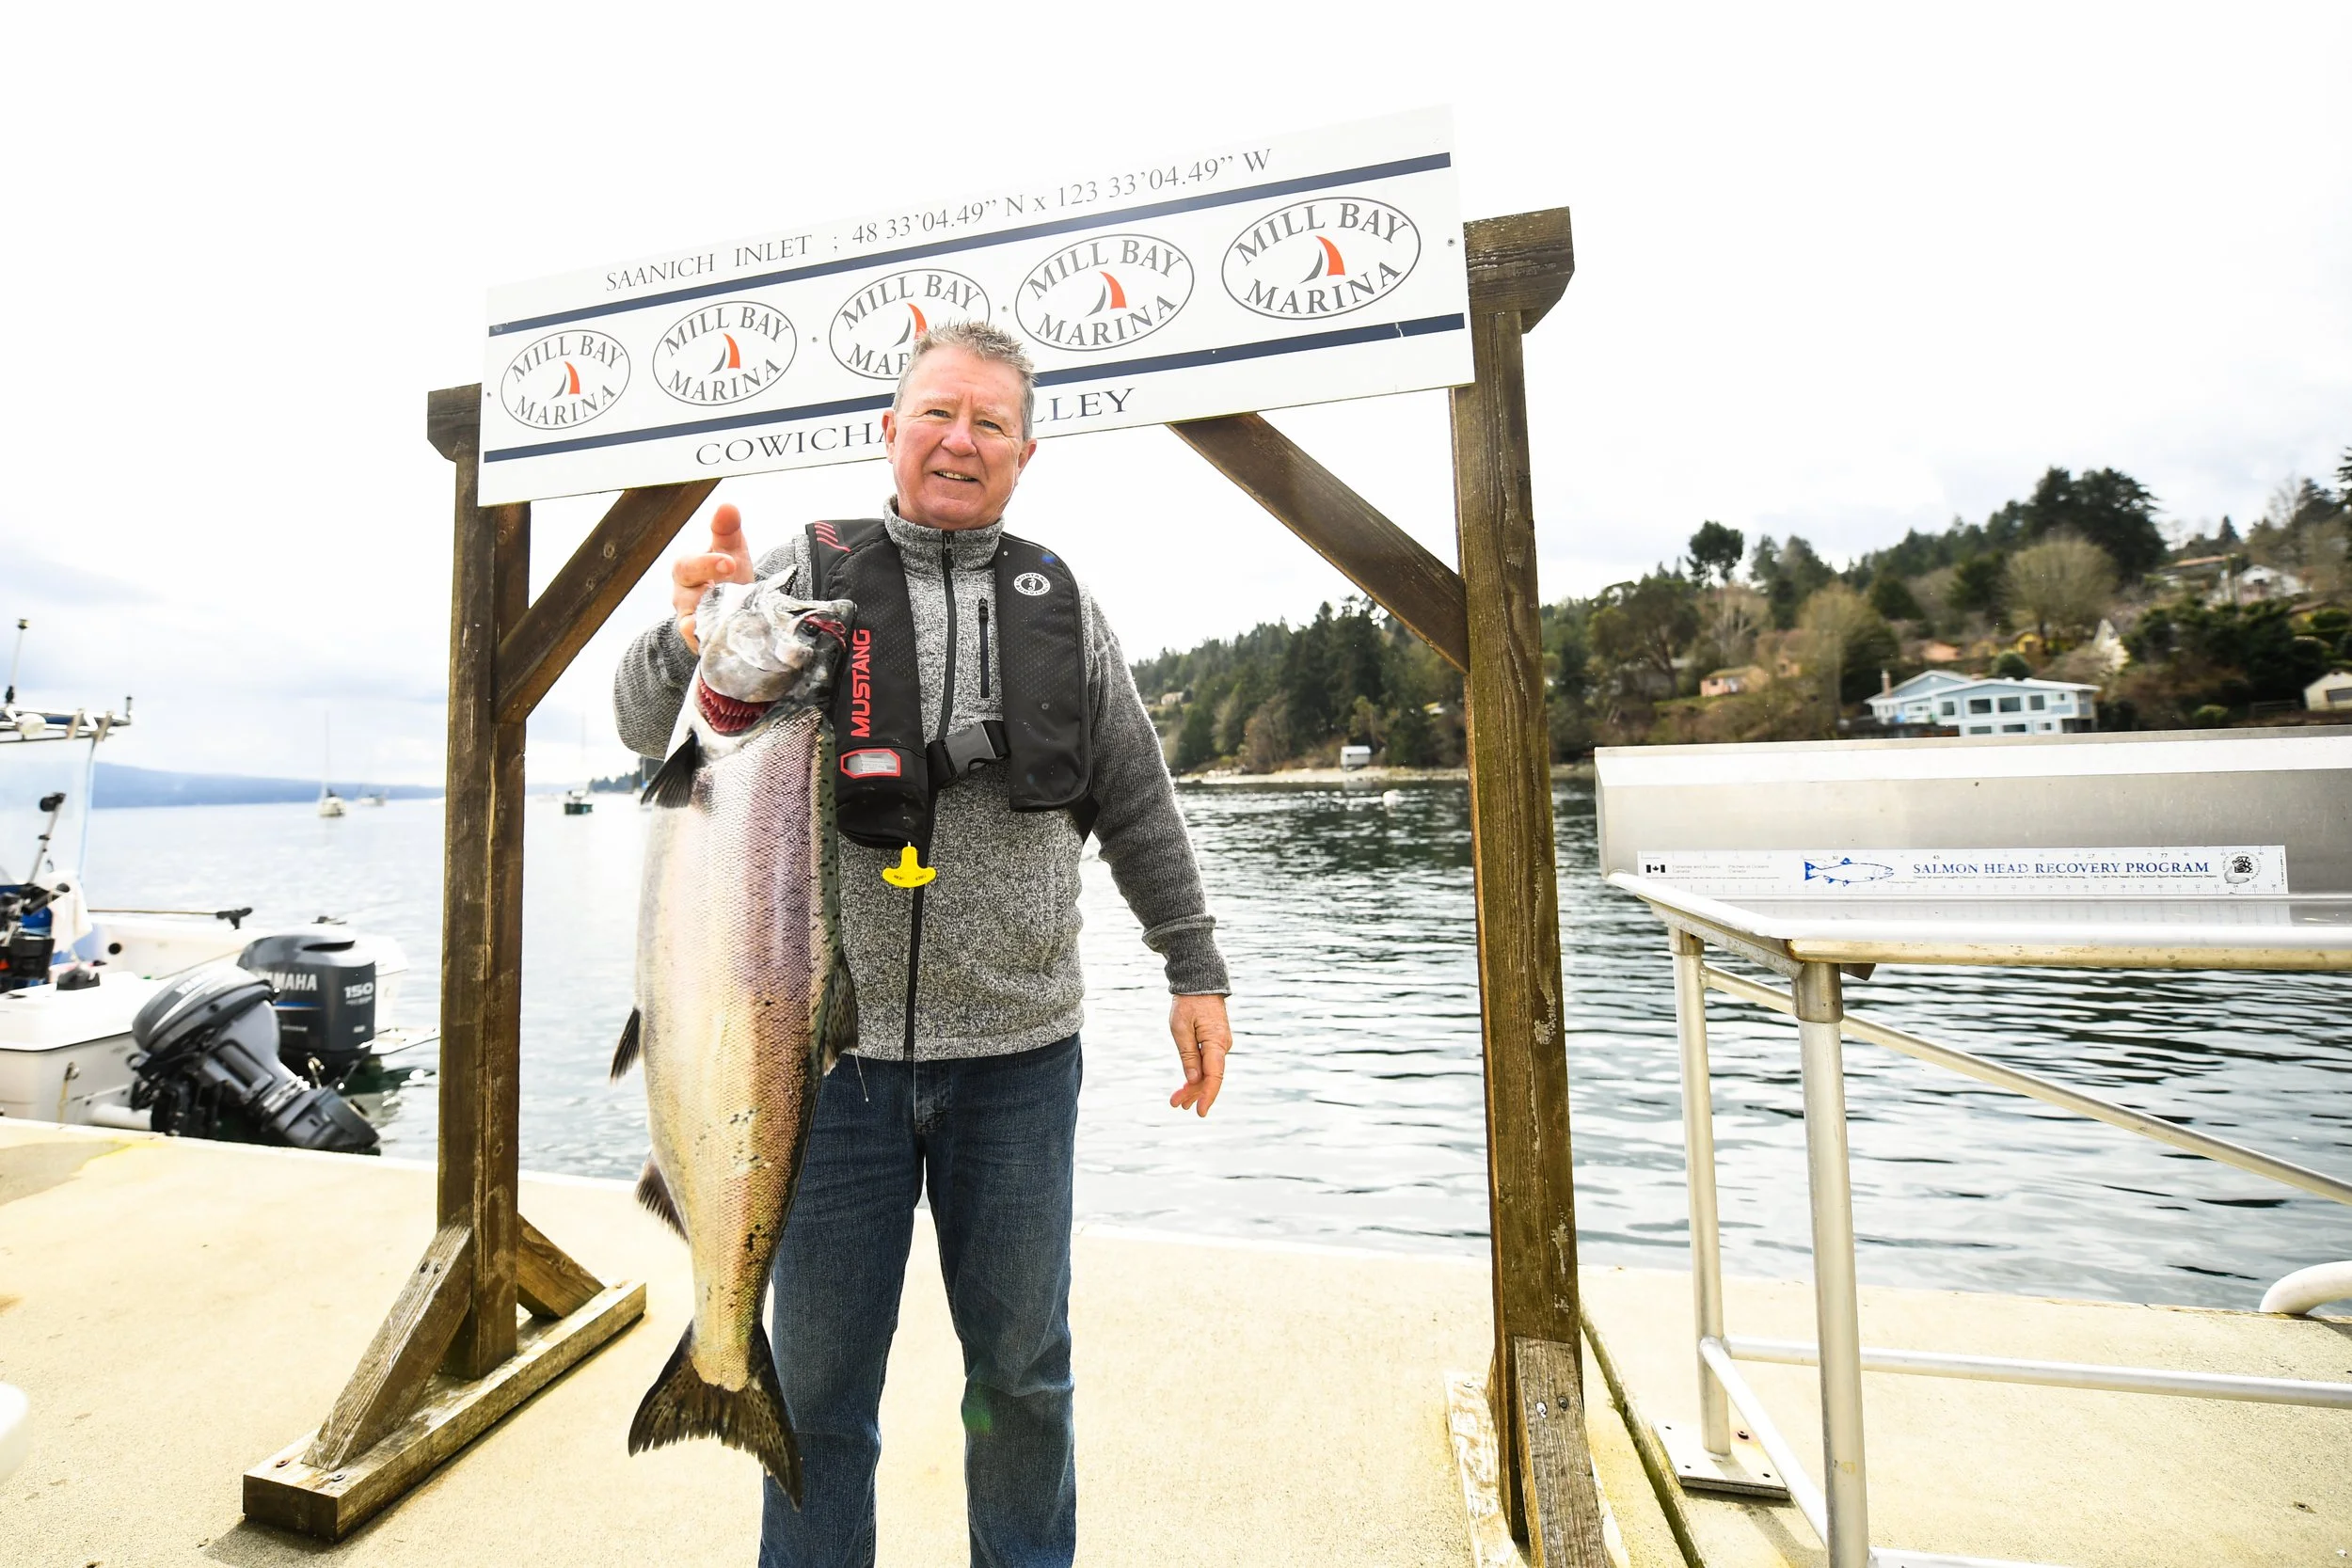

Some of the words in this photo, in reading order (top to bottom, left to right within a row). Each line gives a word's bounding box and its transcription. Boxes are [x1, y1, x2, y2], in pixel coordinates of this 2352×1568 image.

[607, 253, 715, 292] SAANICH
[736, 234, 812, 268] INLET
[852, 222, 878, 245] 48
[1006, 195, 1025, 217] N
[1035, 198, 1047, 212] x
[1057, 181, 1099, 207] 123
[1243, 148, 1271, 172] W
[1234, 204, 1326, 266] MILL
[1338, 202, 1408, 245] BAY
[1027, 242, 1109, 301] MILL
[1120, 239, 1184, 278] BAY
[1244, 261, 1402, 315] MARINA
[841, 276, 914, 332] MILL
[924, 274, 981, 311] BAY
[1036, 295, 1178, 346] MARINA
[664, 308, 729, 356] MILL
[739, 307, 790, 343] BAY
[512, 336, 571, 384] MILL
[580, 336, 624, 369] BAY
[668, 359, 782, 402] MARINA
[515, 384, 616, 426] MARINA
[696, 421, 885, 466] COWICH
[850, 629, 871, 737] MUSTANG
[1914, 863, 1979, 874] SALMON
[1984, 863, 2029, 874] HEAD
[2035, 863, 2121, 874] RECOVERY
[2126, 862, 2210, 873] PROGRAM
[343, 982, 374, 999] 150
